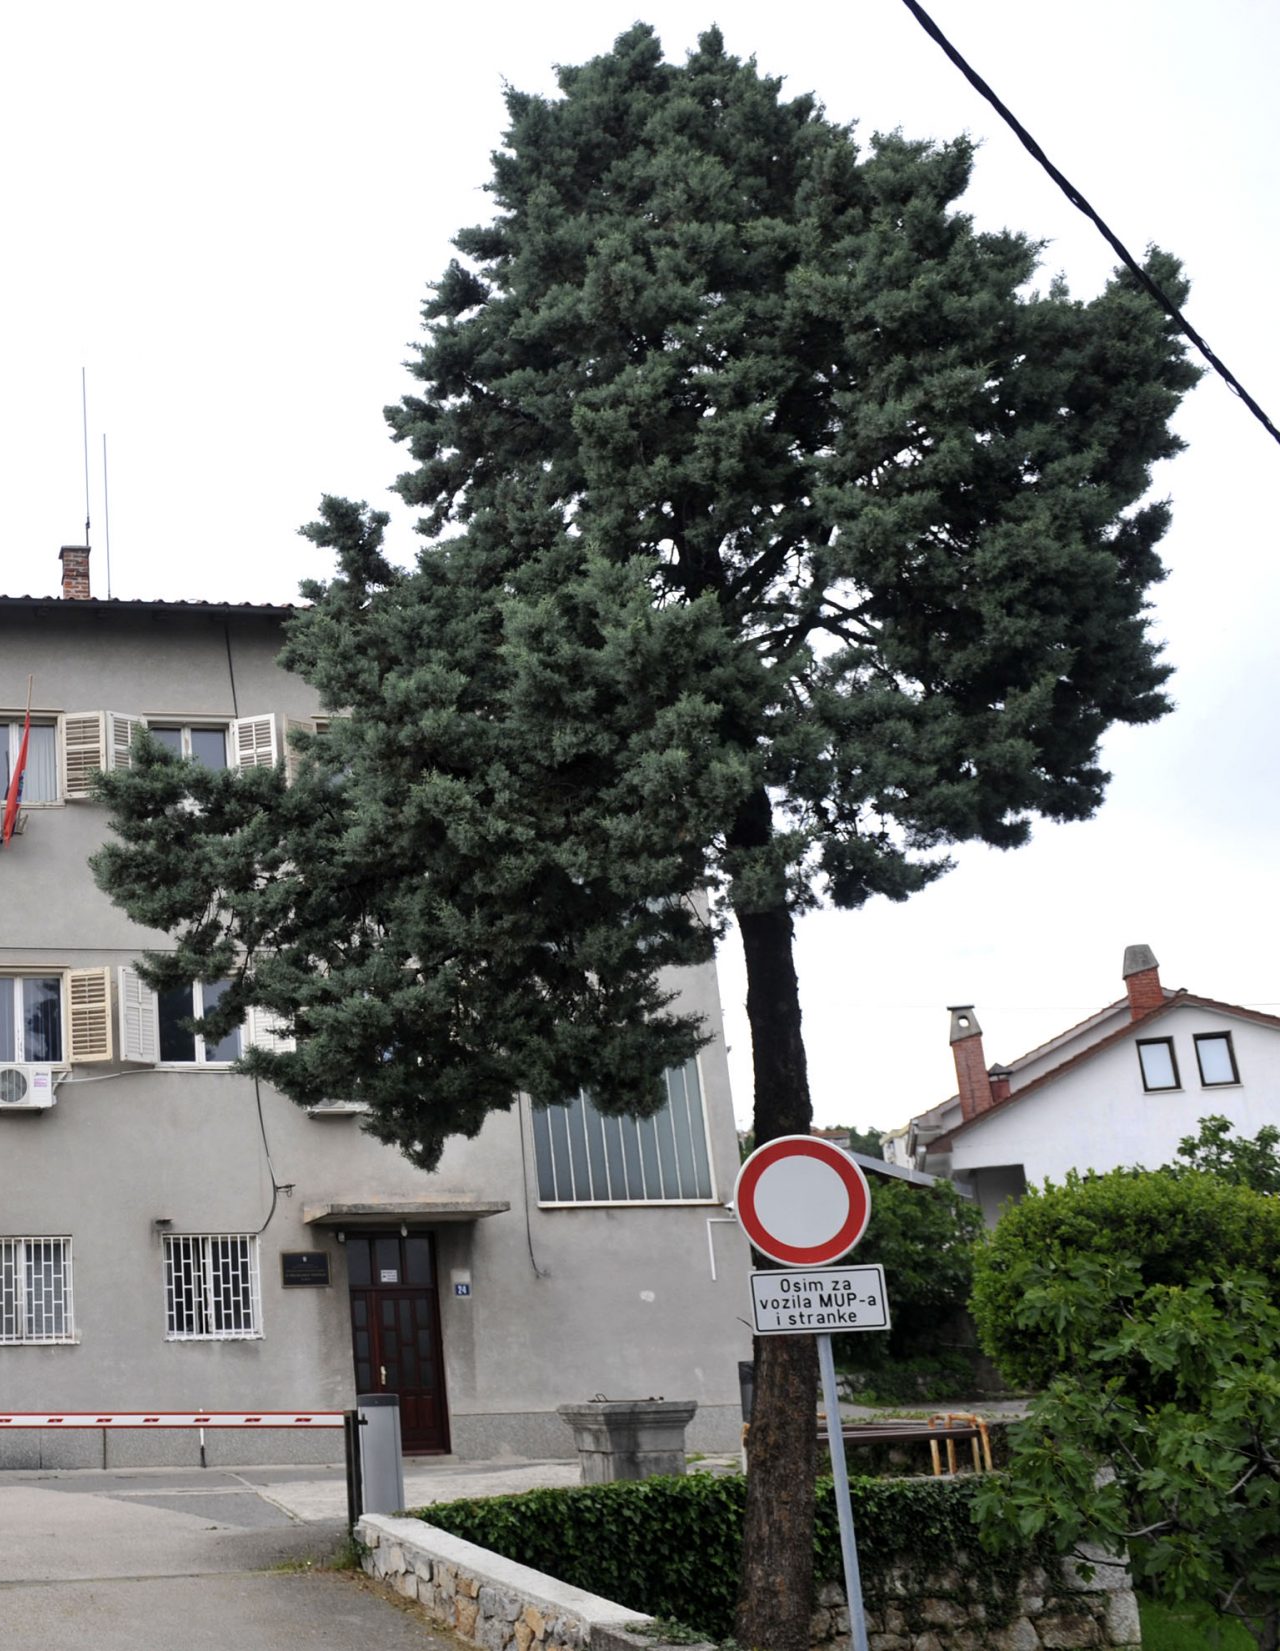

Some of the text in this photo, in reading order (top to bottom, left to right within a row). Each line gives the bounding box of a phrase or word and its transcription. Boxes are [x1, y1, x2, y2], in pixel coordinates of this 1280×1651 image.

[457, 1285, 467, 1294] 24
[780, 1278, 852, 1293] Osim za
[760, 1292, 877, 1310] vozila MUP-a
[776, 1309, 857, 1325] i stranke
